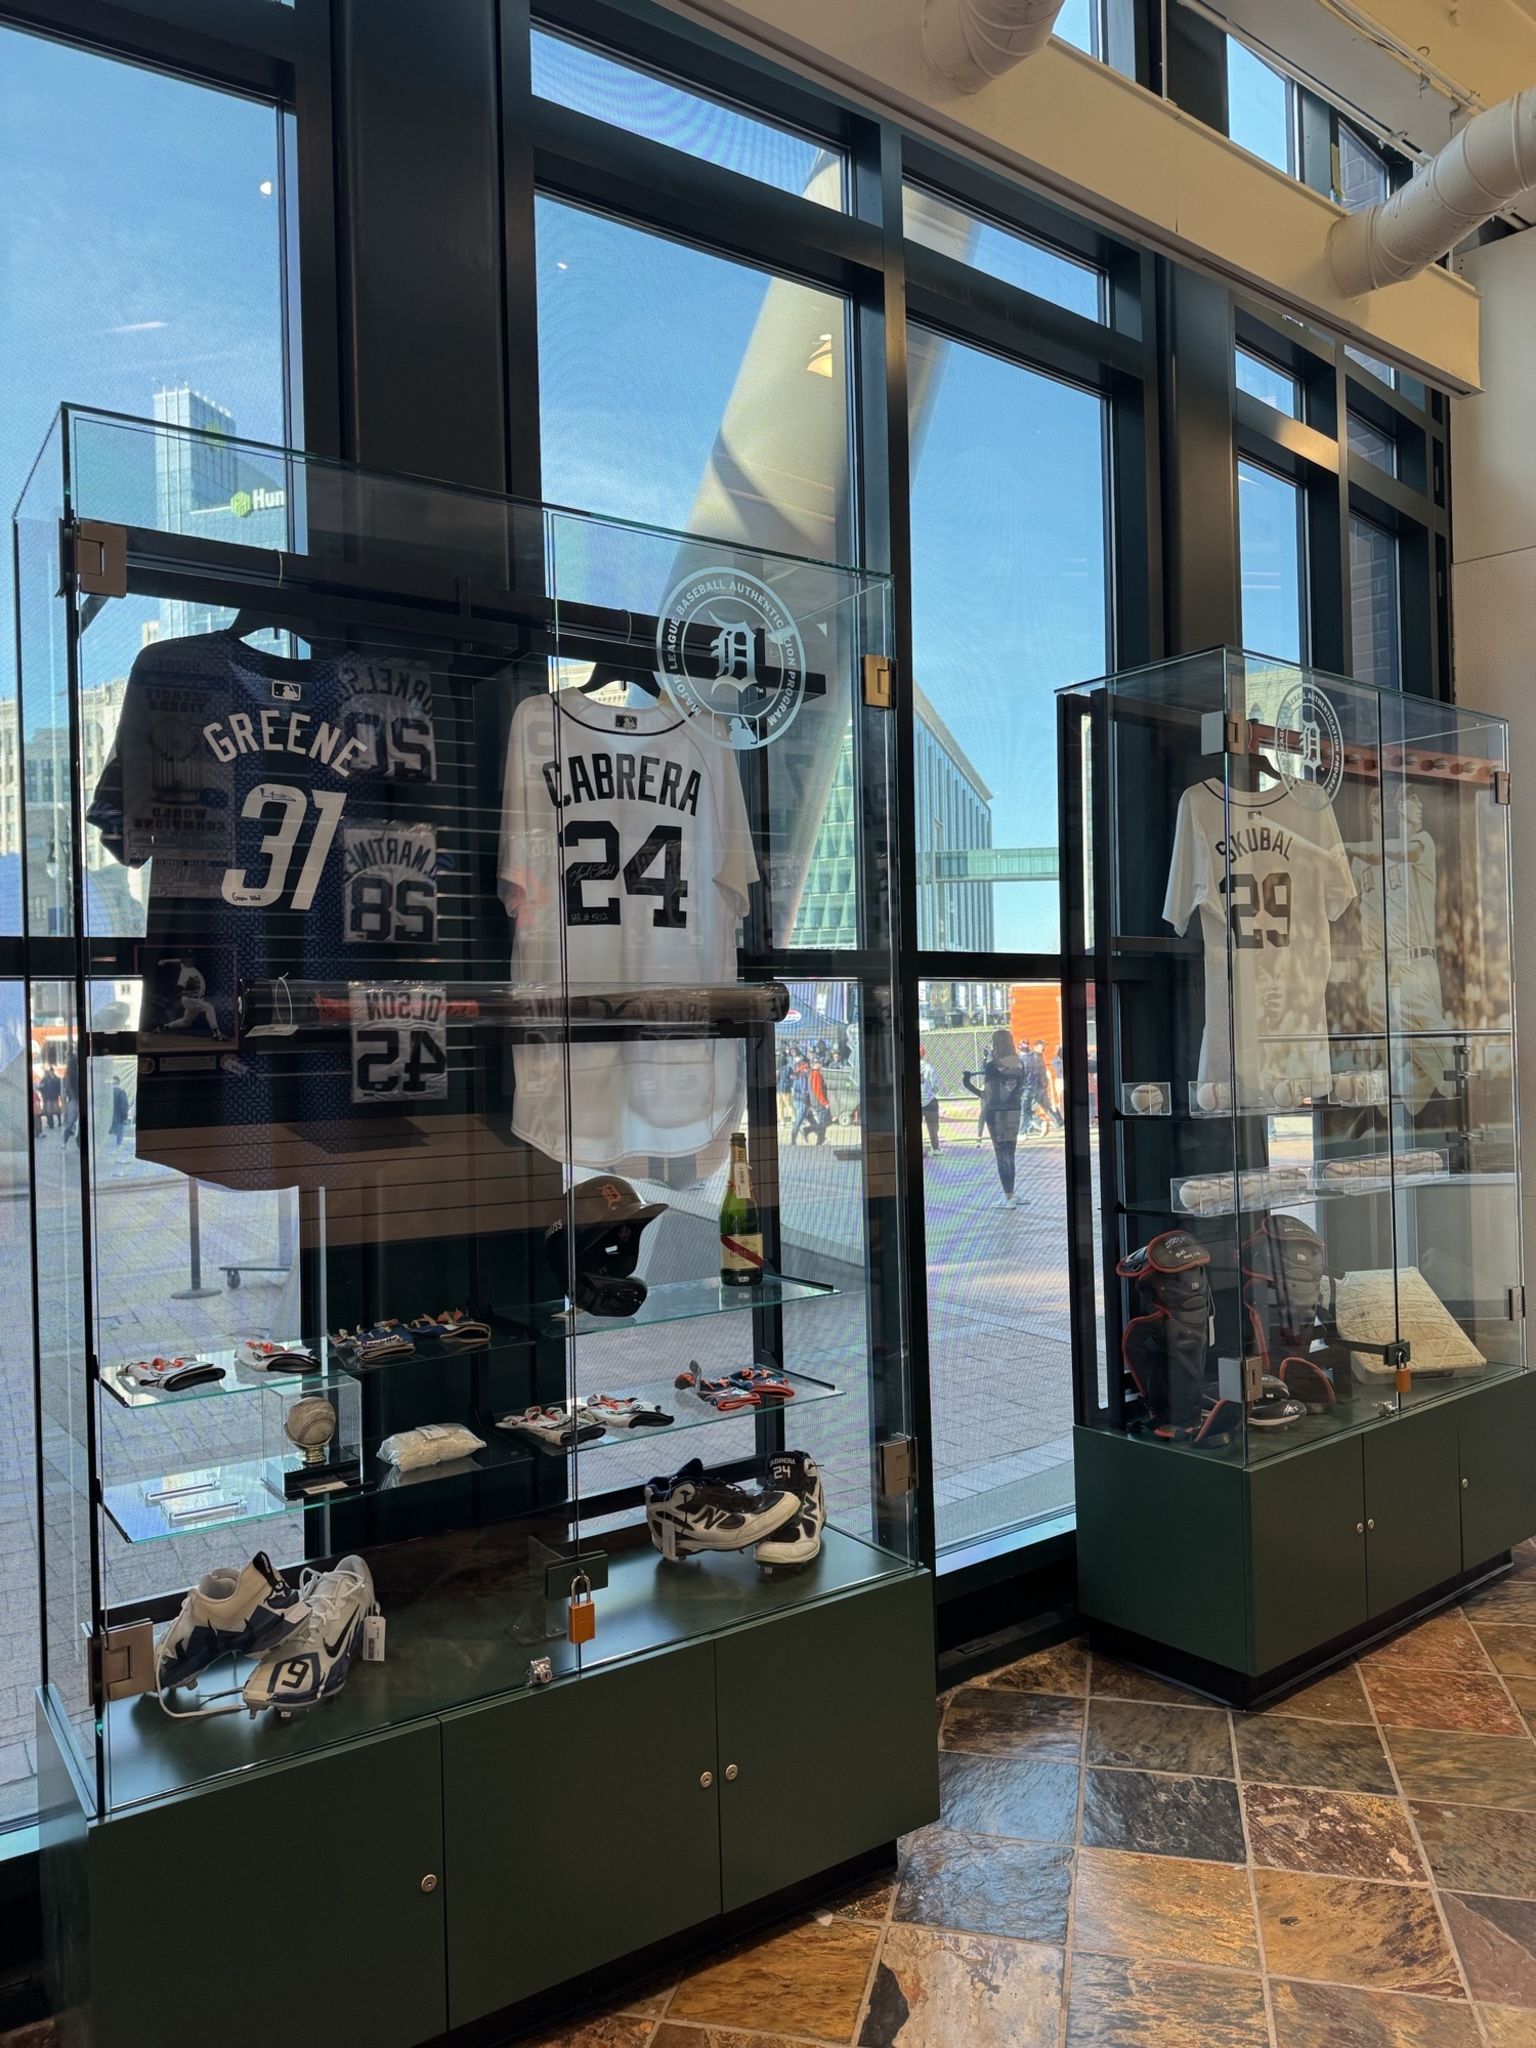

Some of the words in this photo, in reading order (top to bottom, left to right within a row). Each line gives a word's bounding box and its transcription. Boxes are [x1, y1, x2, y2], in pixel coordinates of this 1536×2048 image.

[252, 487, 284, 511] Hun
[676, 580, 726, 616] BASEBALL
[669, 616, 681, 670] LEAGUE
[674, 674, 702, 717] MAJOR
[767, 670, 797, 727] PROGRAM
[203, 710, 368, 777] GREENE
[542, 753, 702, 817] CABRERA
[221, 783, 347, 910] 31
[1215, 827, 1293, 863] SKUBAL
[559, 820, 688, 928] 24
[1219, 872, 1292, 949] 29
[770, 1457, 796, 1467] ABRERA
[773, 1465, 791, 1479] 24
